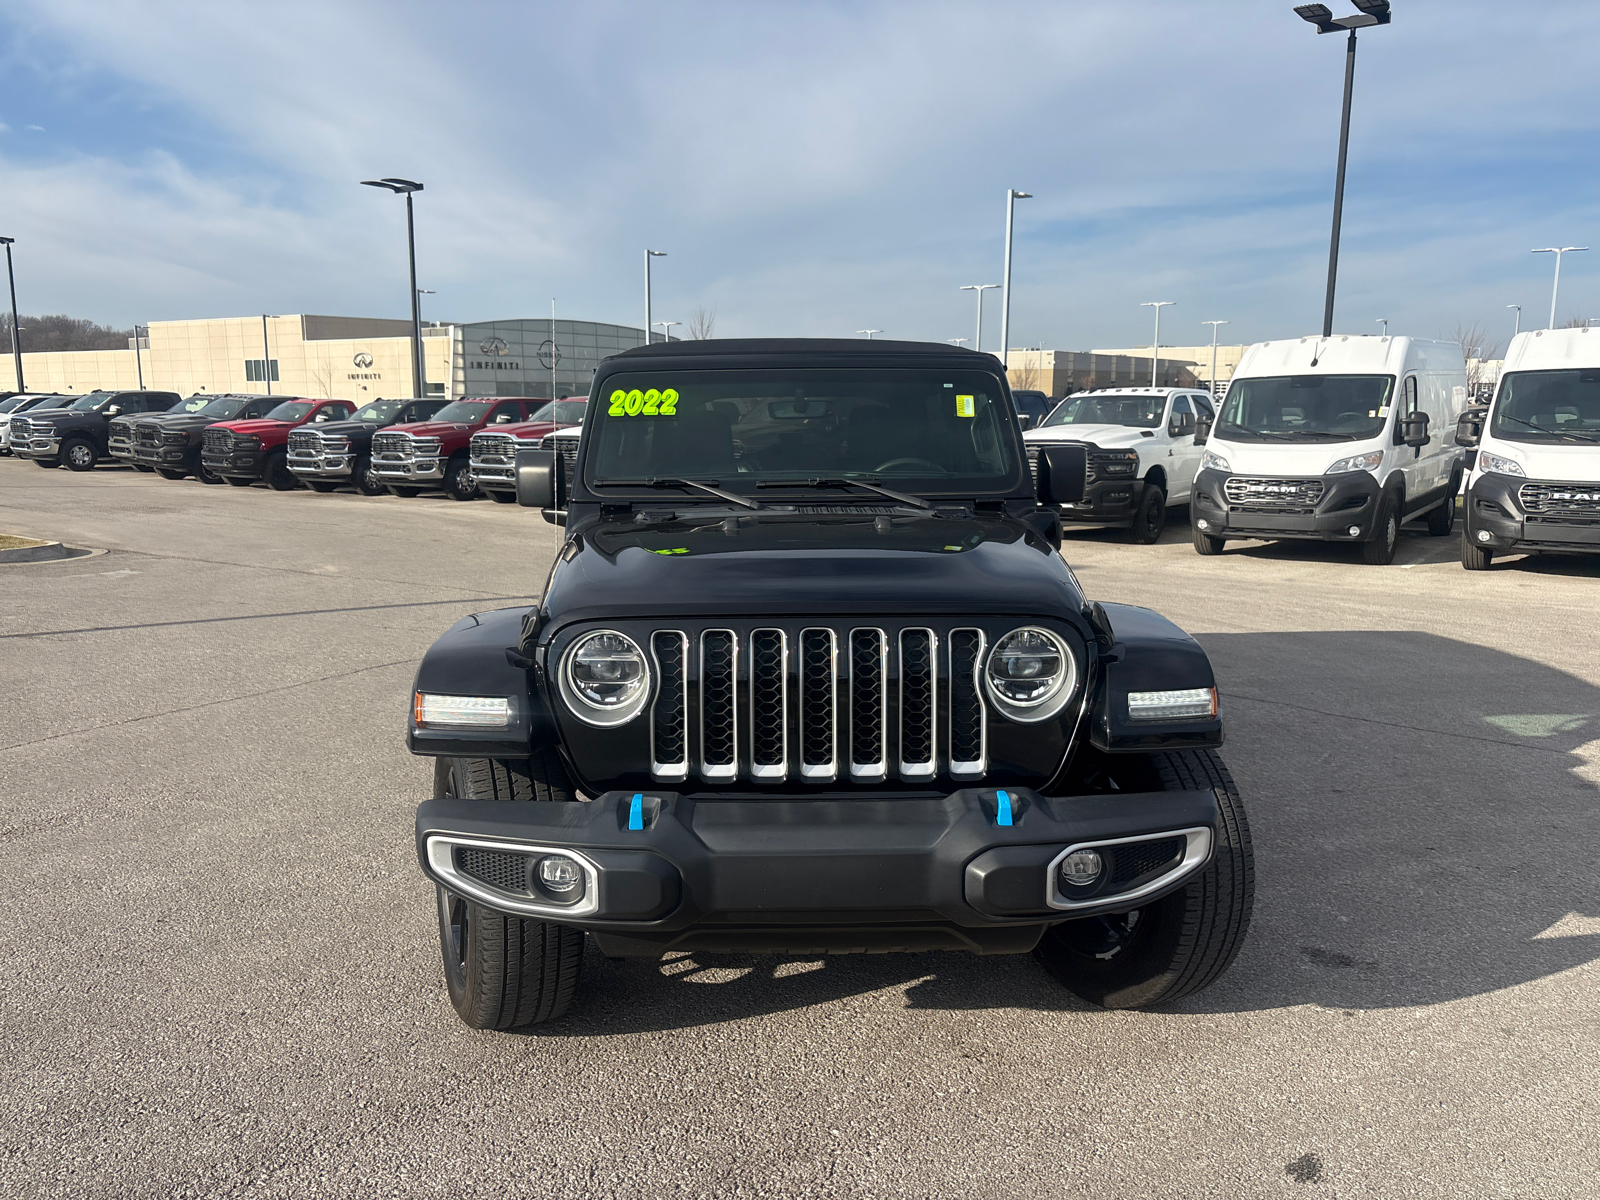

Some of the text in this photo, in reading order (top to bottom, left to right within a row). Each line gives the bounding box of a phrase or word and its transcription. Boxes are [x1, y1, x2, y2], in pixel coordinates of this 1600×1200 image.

[470, 361, 520, 370] INFINITI
[607, 388, 679, 417] 2022
[1249, 485, 1297, 493] RAM
